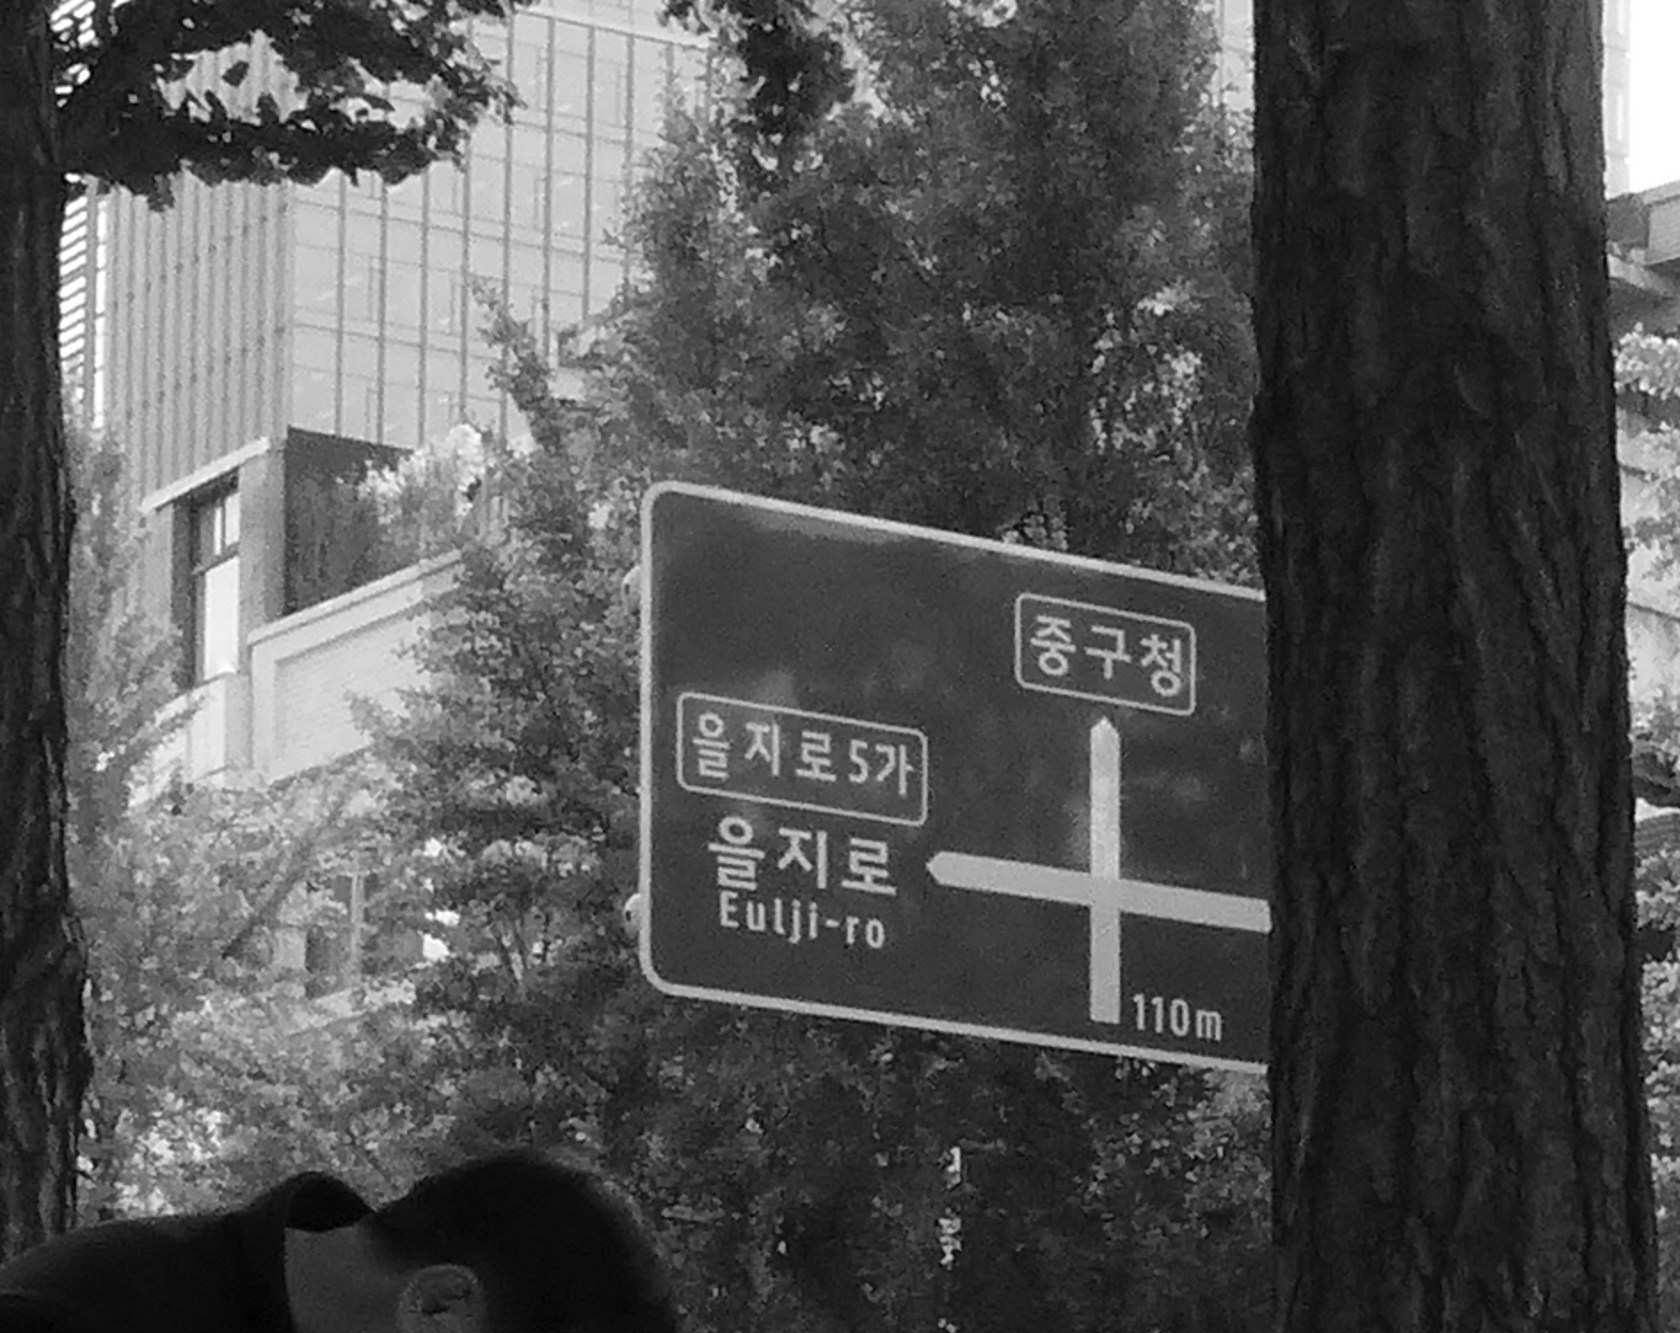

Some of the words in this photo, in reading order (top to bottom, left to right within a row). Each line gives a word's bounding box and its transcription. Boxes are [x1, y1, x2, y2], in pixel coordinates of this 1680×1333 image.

[1029, 615, 1183, 698] 중구청
[691, 712, 914, 795] 을지로5가
[707, 815, 897, 896] 을지로
[719, 893, 886, 950] Eulji-ro
[1132, 993, 1223, 1041] 110m
